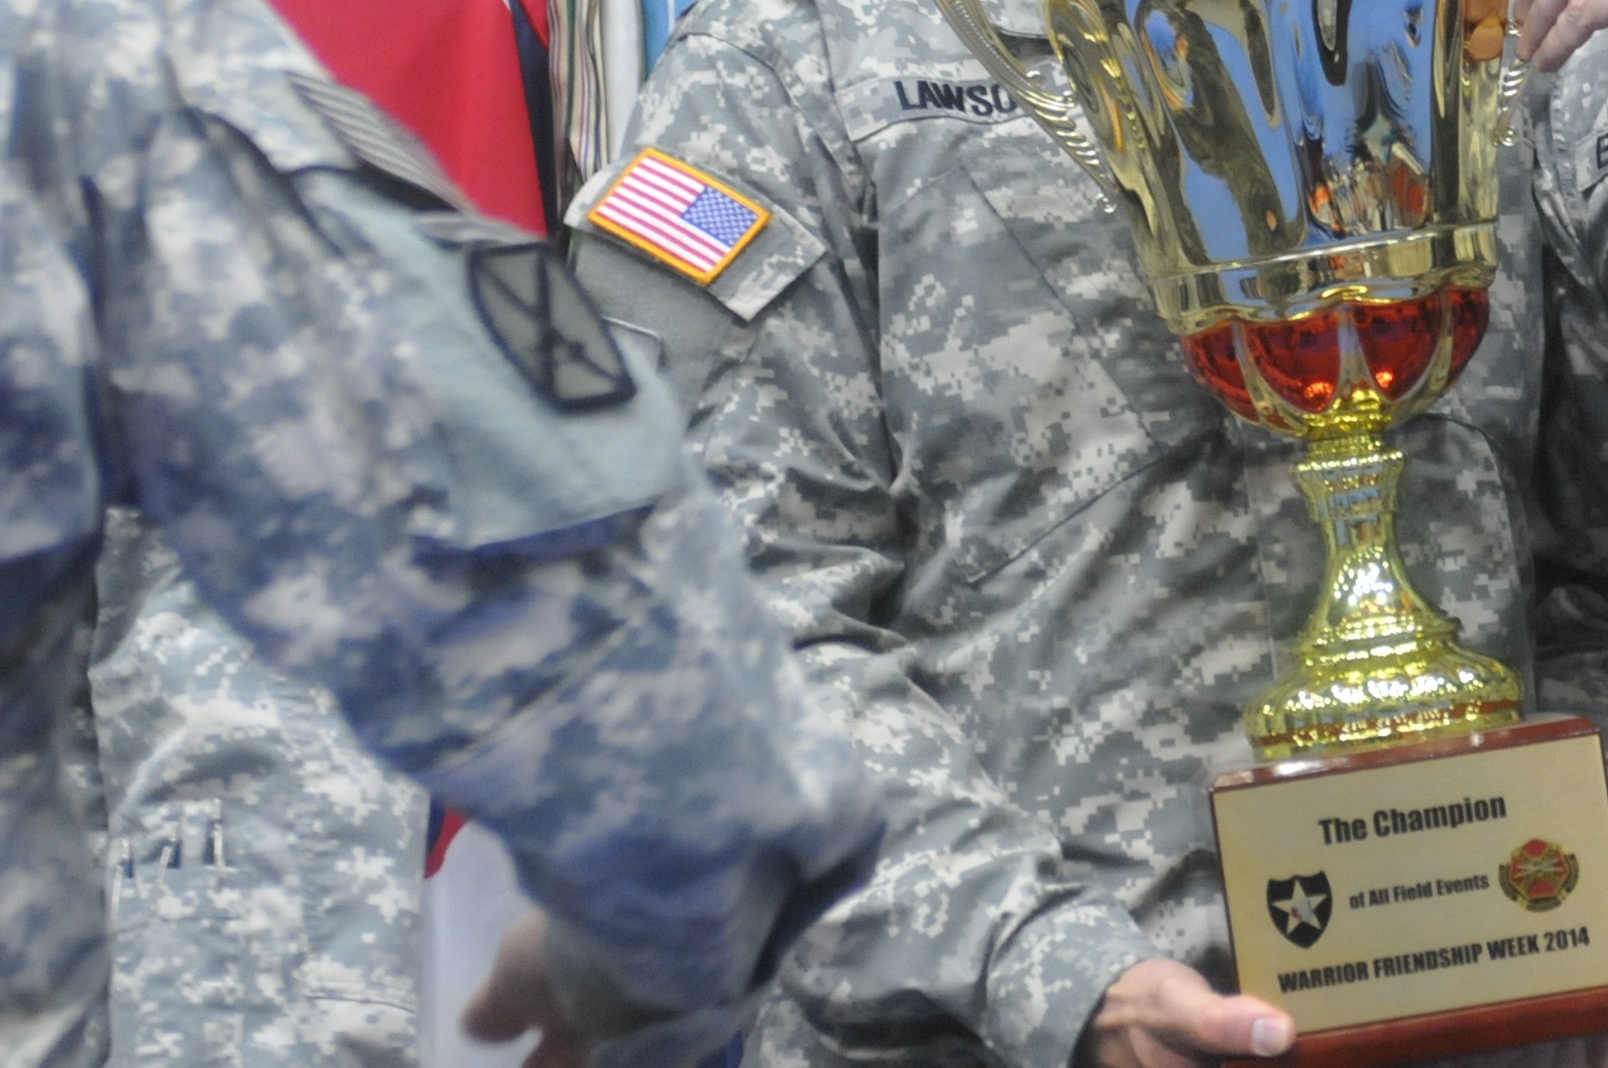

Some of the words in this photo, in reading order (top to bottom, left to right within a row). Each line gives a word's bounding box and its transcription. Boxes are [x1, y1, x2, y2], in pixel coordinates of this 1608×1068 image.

[893, 80, 1018, 117] LAWSO
[1318, 817, 1368, 846] The
[1373, 796, 1507, 838] Champion
[1349, 892, 1365, 909] of
[1369, 888, 1390, 907] All
[1393, 881, 1433, 902] Field
[1436, 875, 1490, 896] Events
[1277, 960, 1369, 994] WARRIOR
[1373, 943, 1483, 979] FRIENDSHIP
[1486, 934, 1540, 961] WEEK
[1544, 926, 1590, 953] 2014
